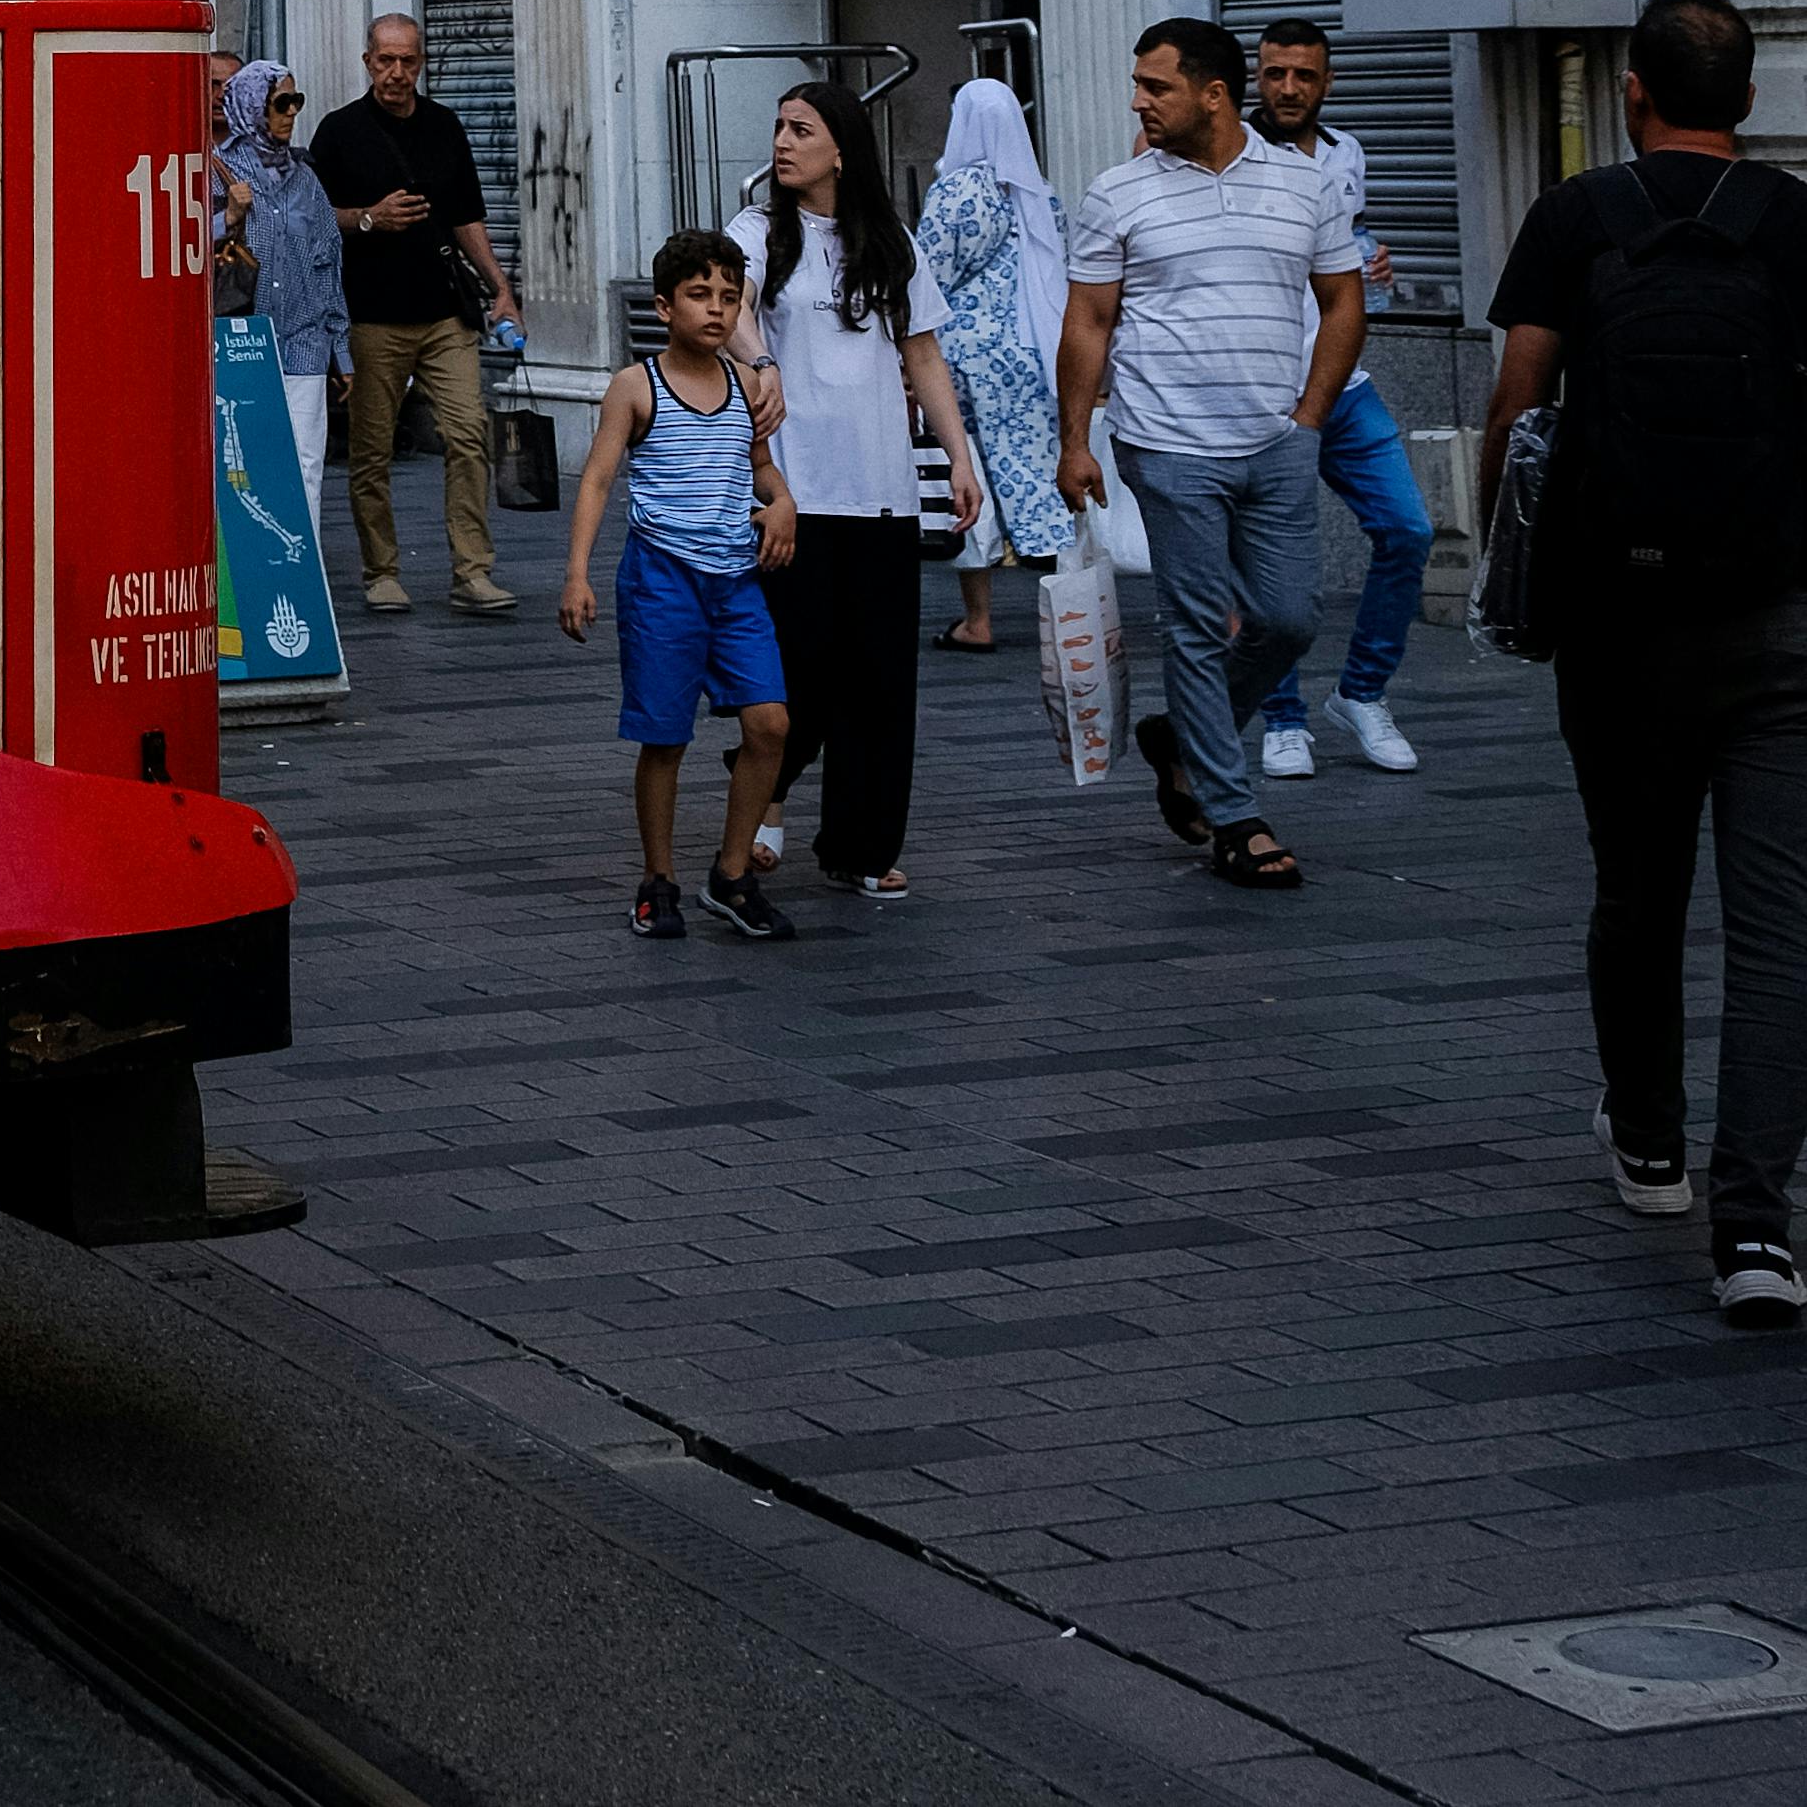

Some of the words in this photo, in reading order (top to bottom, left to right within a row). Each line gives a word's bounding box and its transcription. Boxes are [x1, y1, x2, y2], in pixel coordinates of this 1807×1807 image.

[126, 153, 205, 279] 115
[226, 348, 265, 362] Senin
[105, 565, 199, 620] ASILMAK
[90, 637, 129, 685] VE
